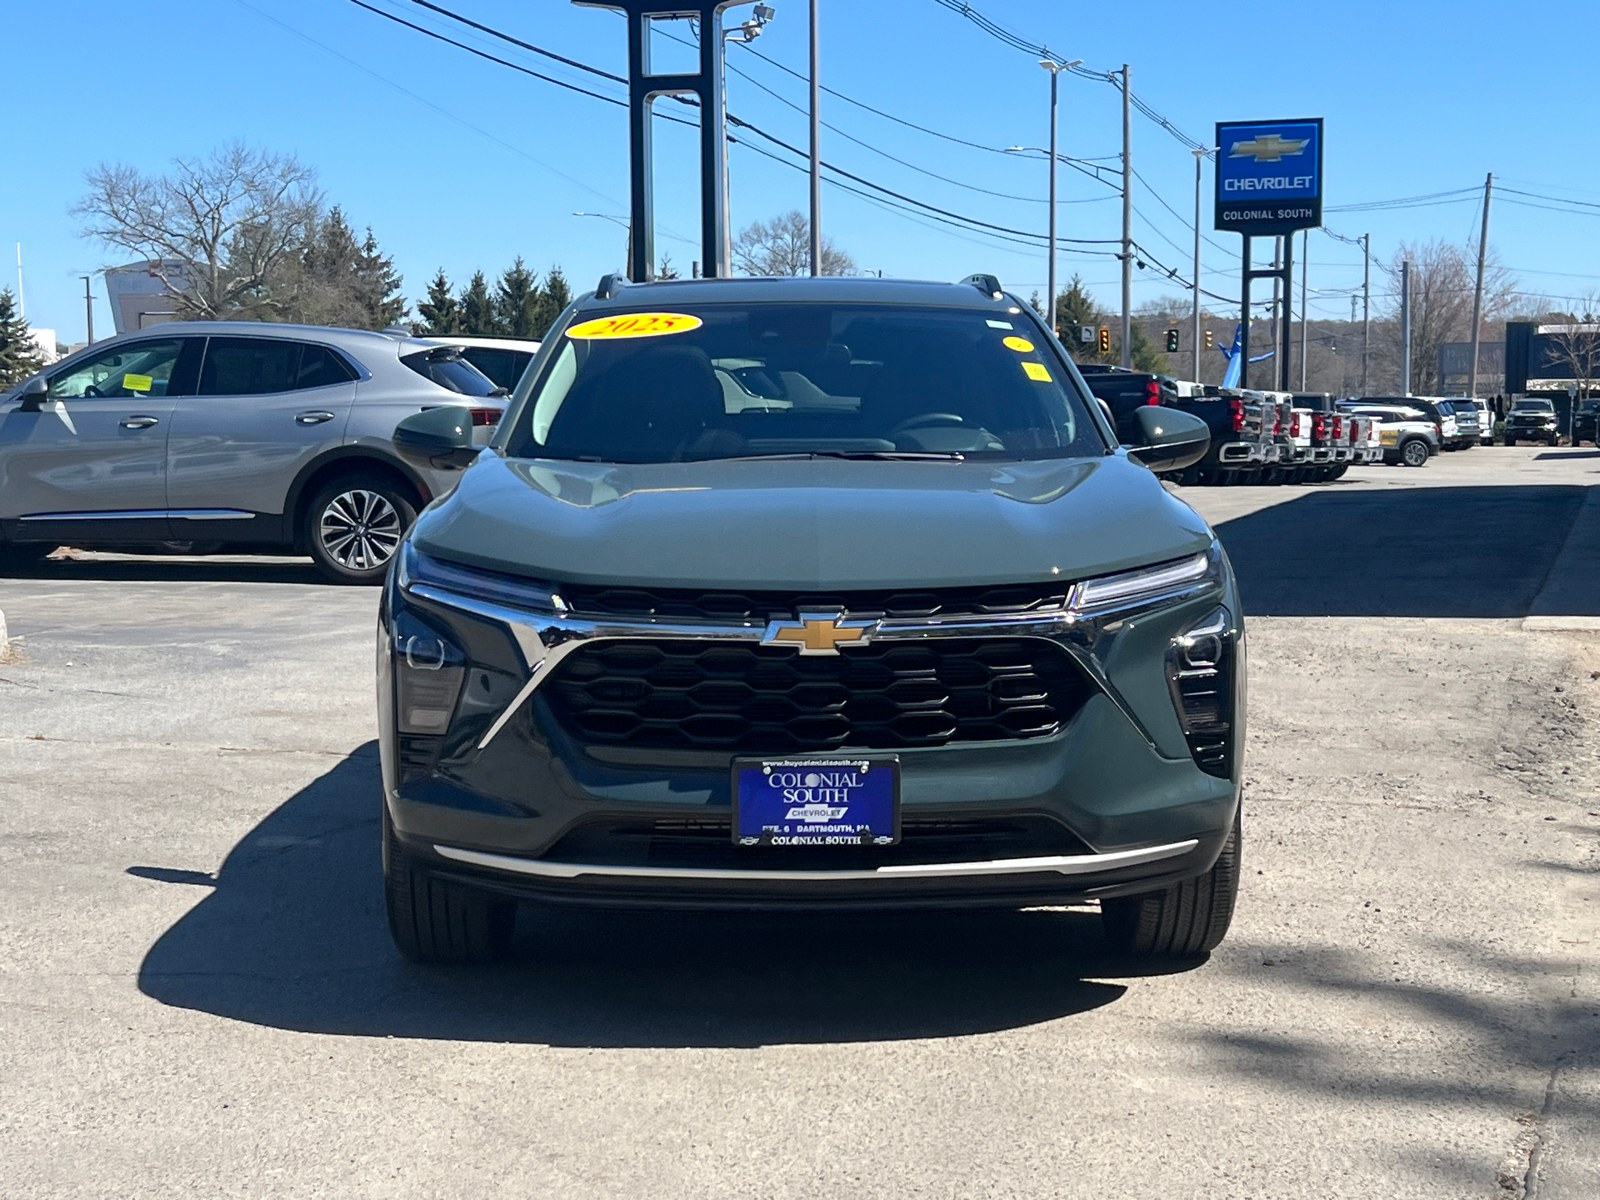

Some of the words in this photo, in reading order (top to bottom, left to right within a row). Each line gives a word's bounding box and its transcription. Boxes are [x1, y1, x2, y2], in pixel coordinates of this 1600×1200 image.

[1224, 175, 1313, 191] CHEVROLET
[1223, 210, 1274, 221] COLONIAL
[1277, 208, 1313, 219] SOUTH
[588, 317, 682, 336] 2025
[768, 772, 864, 788] COLONIAL
[783, 788, 850, 803] SOUTH
[791, 809, 842, 817] CHEVROLET
[784, 825, 790, 833] 6
[797, 825, 855, 834] DARTMOUTH,
[771, 836, 825, 845] COLONIAL
[825, 836, 862, 845] SOUTH
